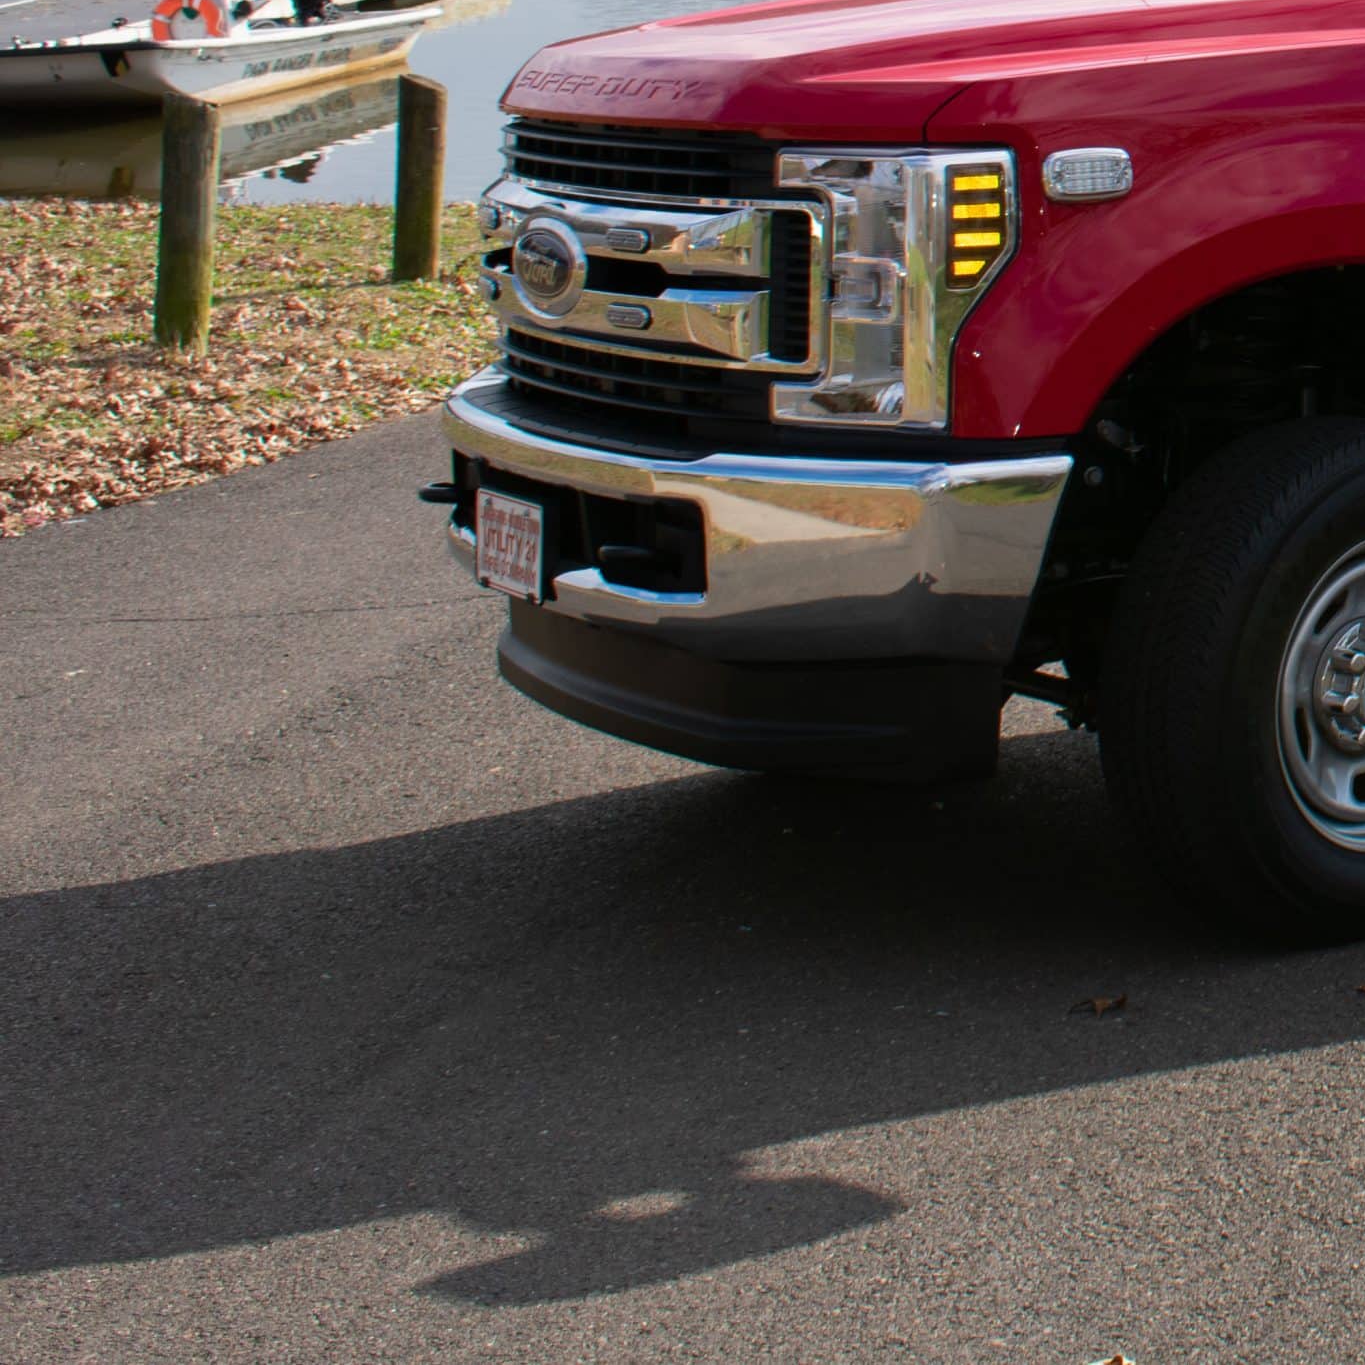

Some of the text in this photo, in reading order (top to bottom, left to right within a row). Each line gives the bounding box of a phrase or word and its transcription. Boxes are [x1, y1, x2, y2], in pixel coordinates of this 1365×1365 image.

[515, 70, 704, 100] SUPER DUTY
[482, 526, 523, 557] UTILITY
